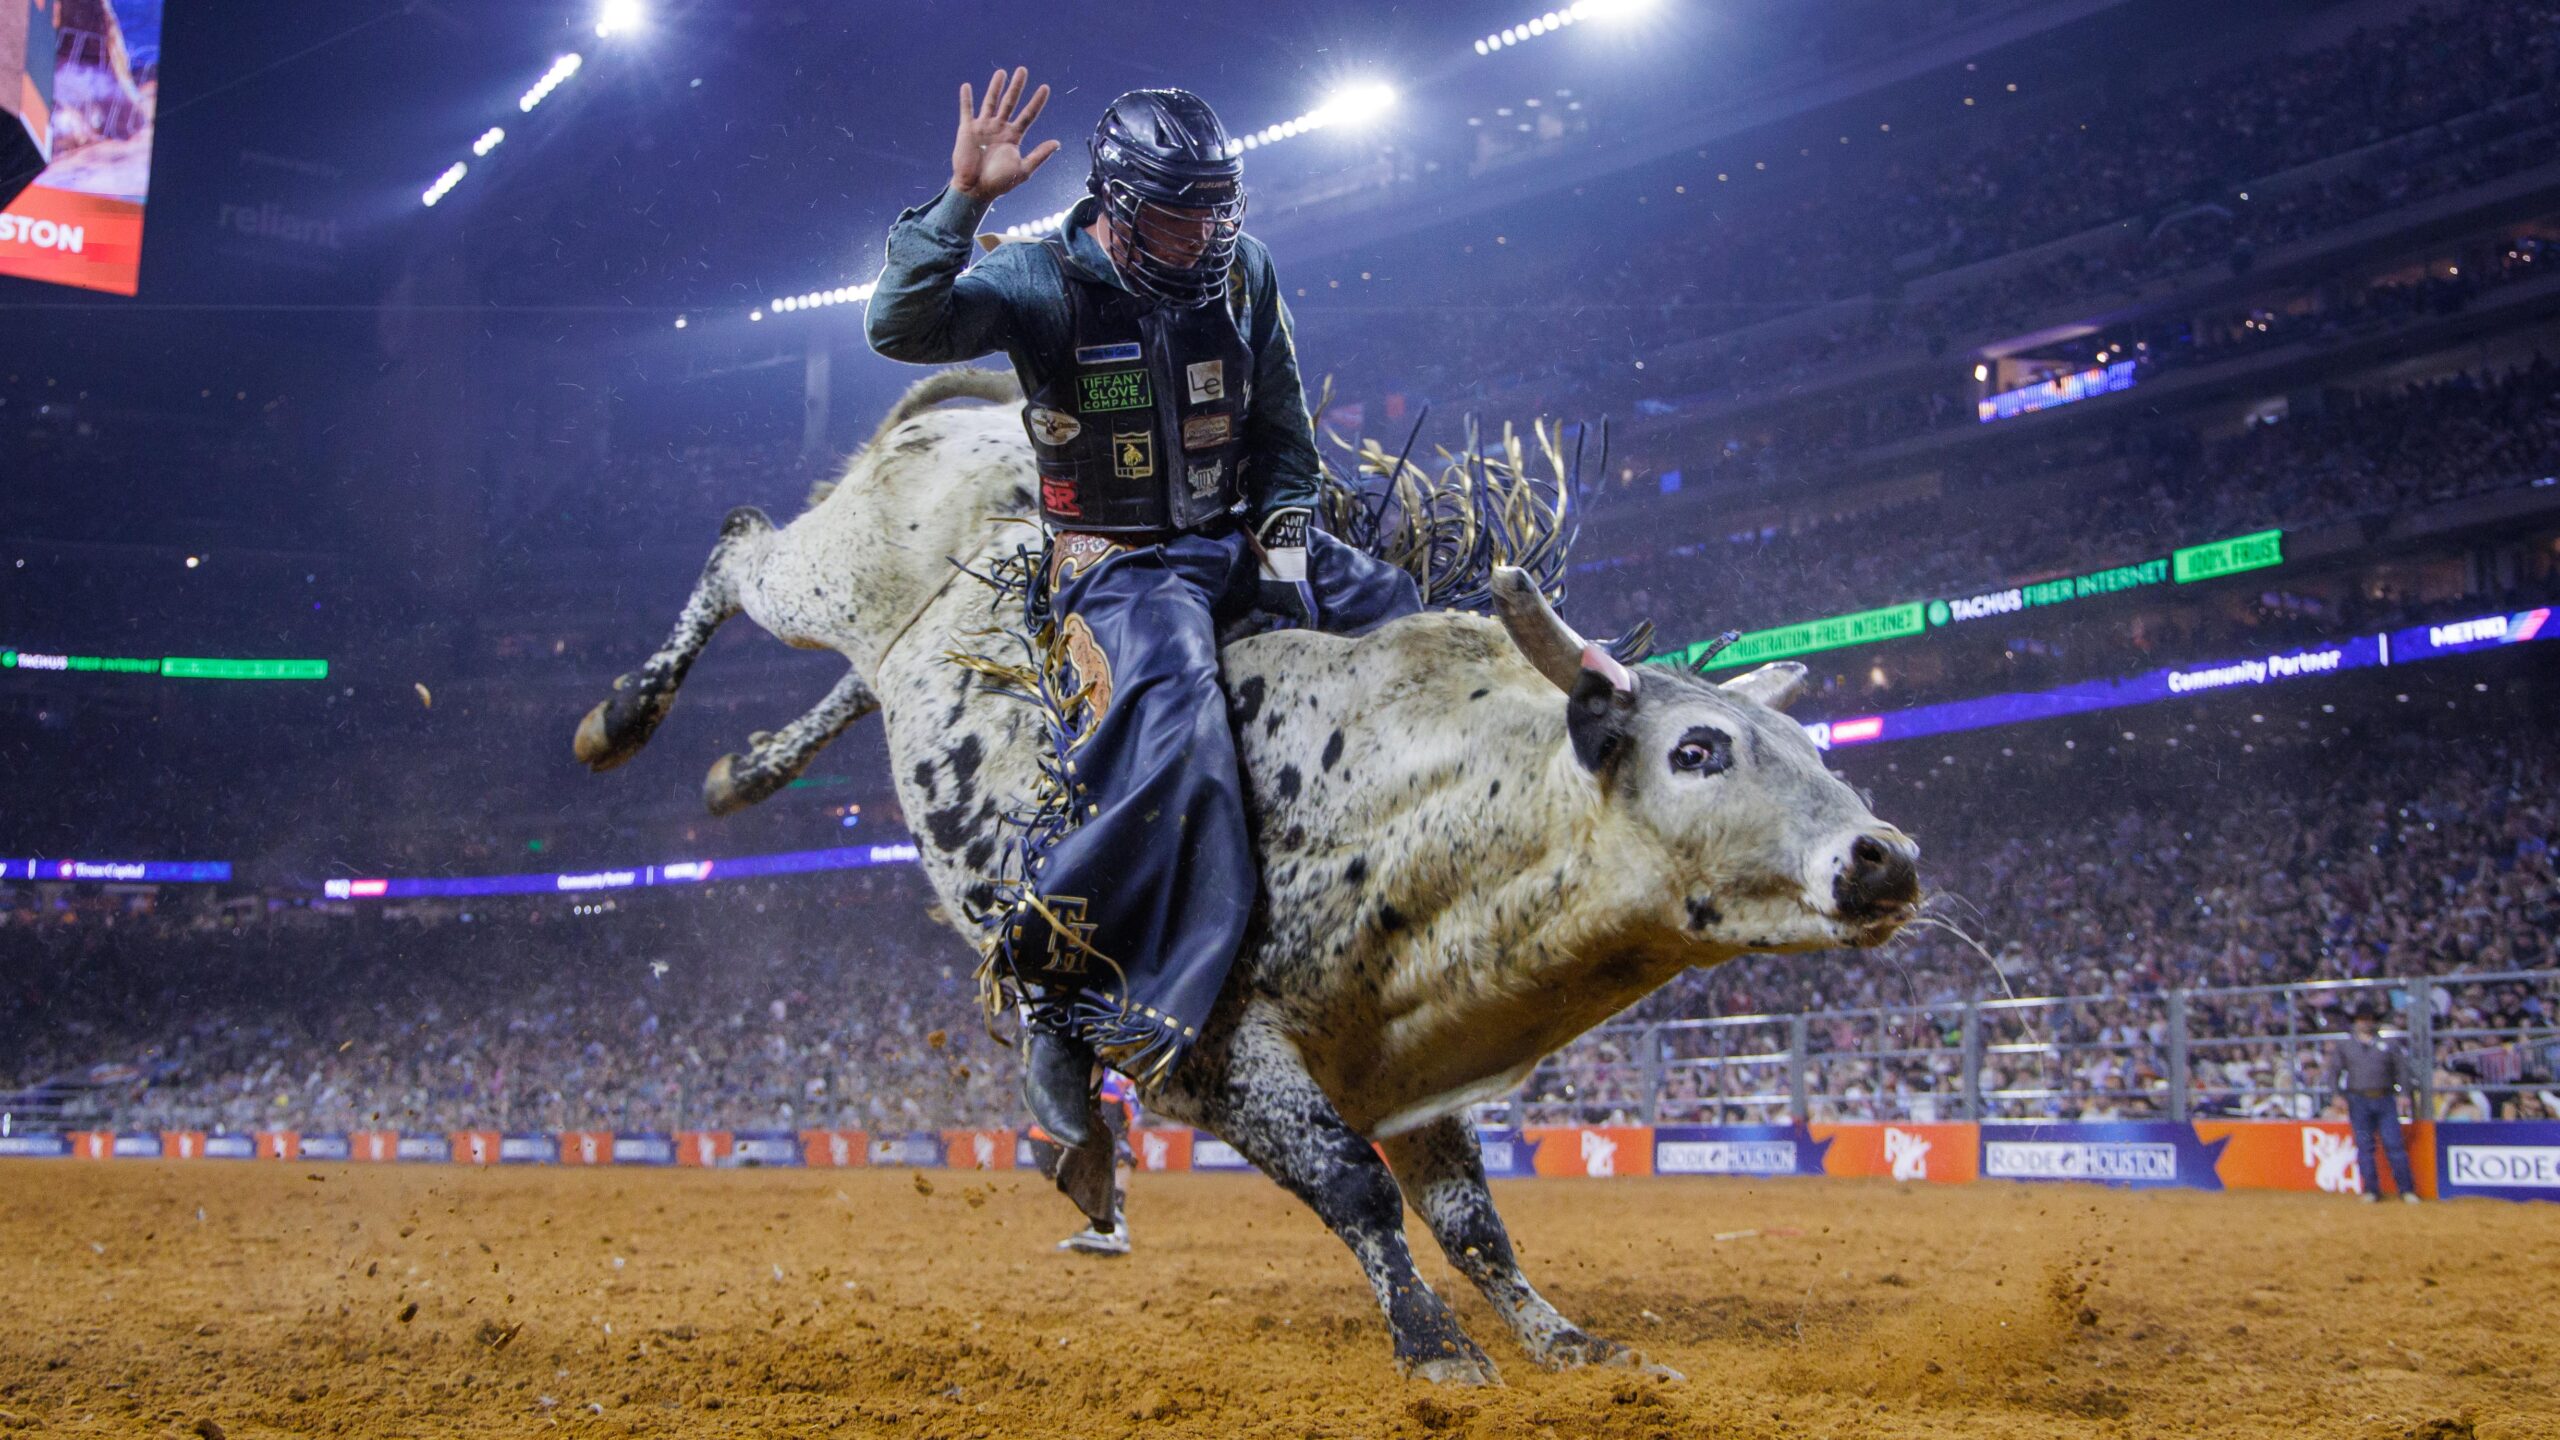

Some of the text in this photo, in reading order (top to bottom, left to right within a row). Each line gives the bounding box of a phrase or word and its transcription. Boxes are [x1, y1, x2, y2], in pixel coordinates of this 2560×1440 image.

[1082, 373, 1142, 389] TIFFANY
[1083, 396, 1147, 410] COMPANY
[1088, 385, 1139, 400] GLOVE
[1949, 558, 2168, 622] TACHUS FIBER INTERNET
[2168, 649, 2342, 693] Community Partner
[2454, 1151, 2560, 1180] RODE
